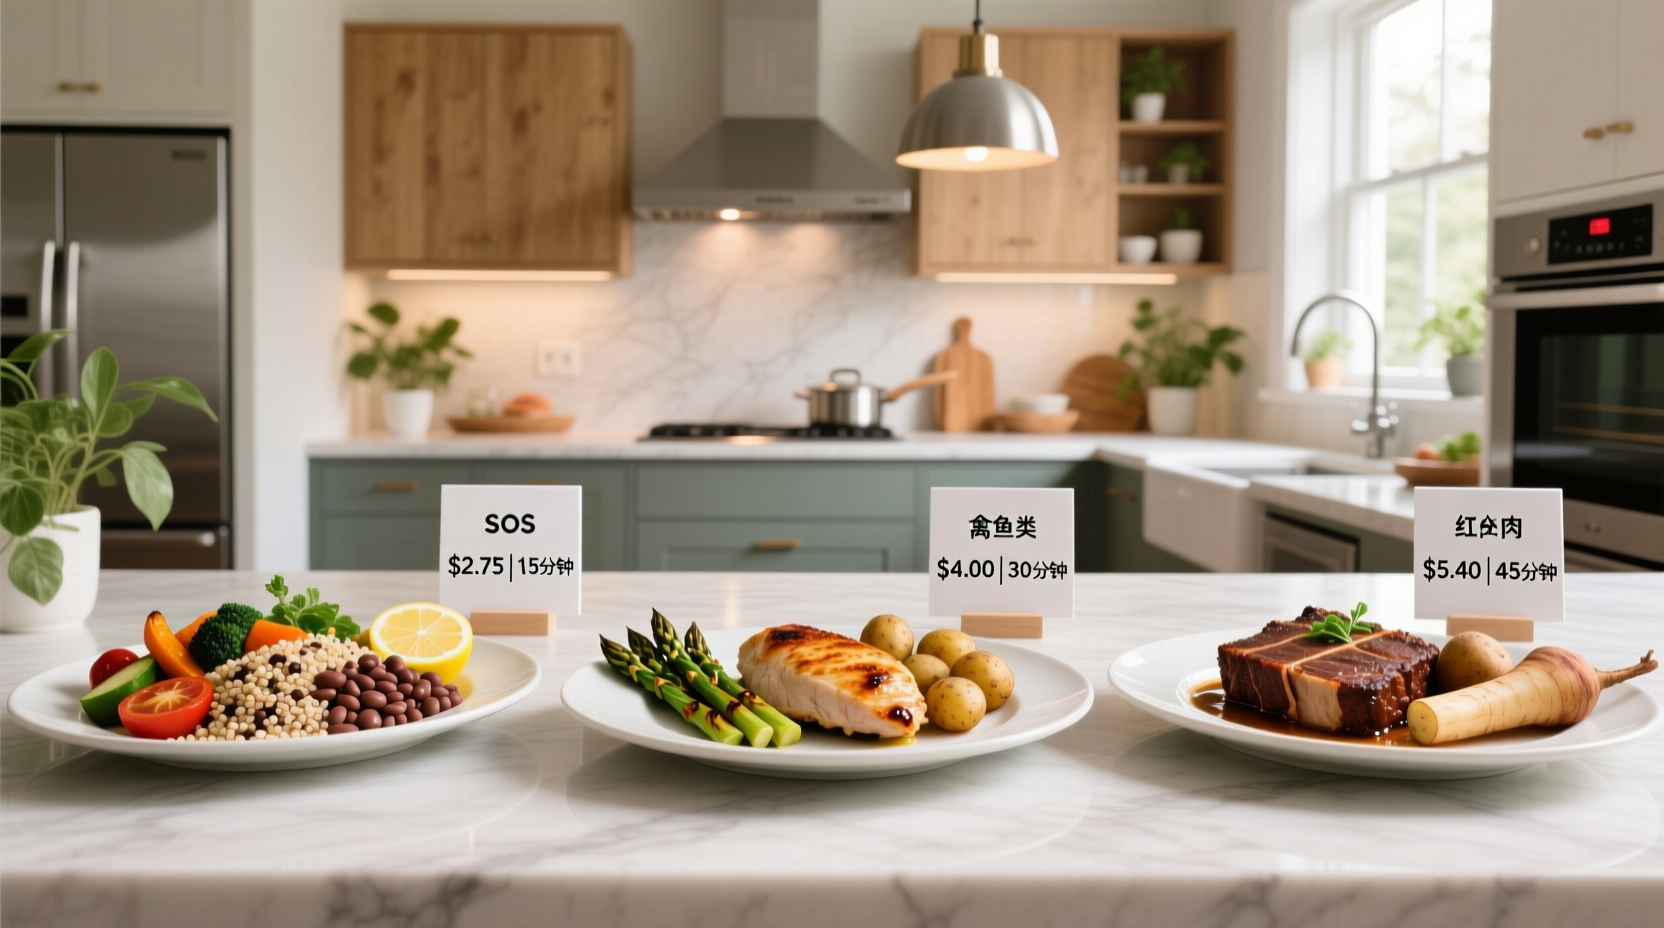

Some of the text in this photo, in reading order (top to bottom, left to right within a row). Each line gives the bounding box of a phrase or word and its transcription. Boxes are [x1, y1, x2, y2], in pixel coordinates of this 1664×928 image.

[484, 513, 536, 535] SOS
[448, 552, 574, 579] $2.75 15分钟
[937, 556, 1068, 582] $4.00 30分钟
[1423, 555, 1558, 584] $5.40 45分钟
